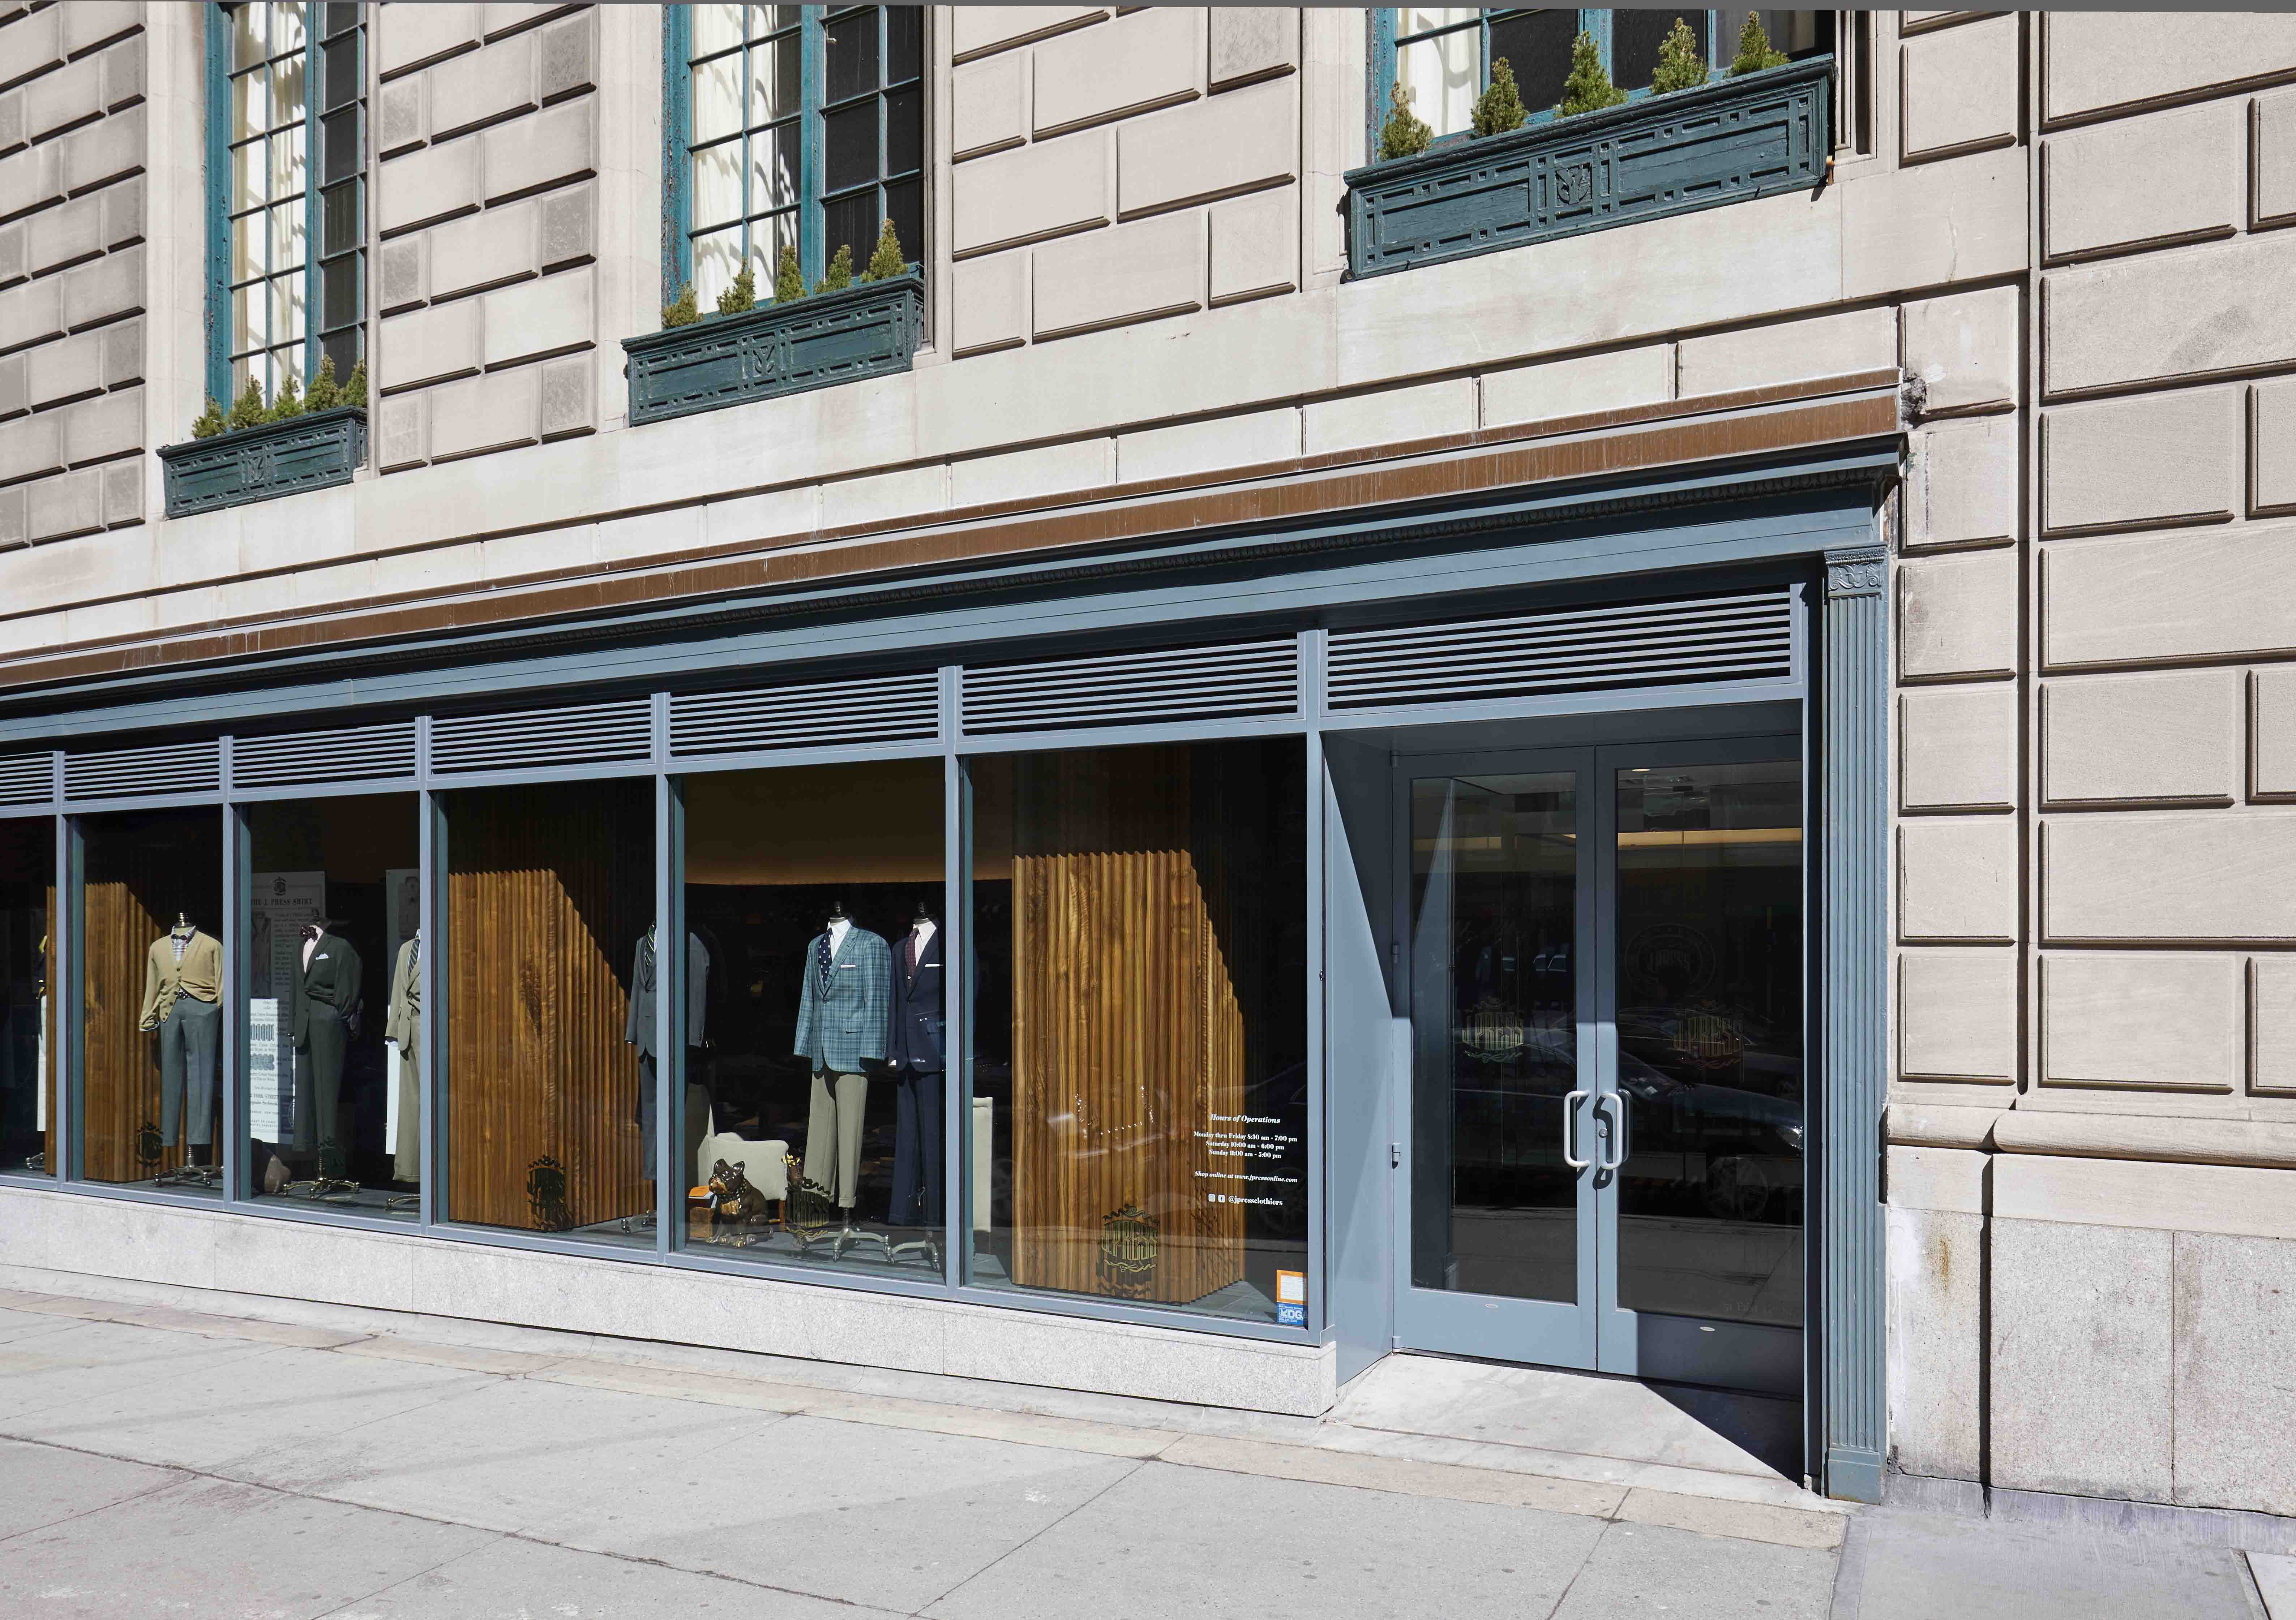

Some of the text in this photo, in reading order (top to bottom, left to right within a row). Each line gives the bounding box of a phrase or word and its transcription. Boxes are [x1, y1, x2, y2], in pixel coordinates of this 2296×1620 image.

[1475, 1012, 1524, 1050] PRESS
[1234, 1174, 1298, 1183] www.jpressonline.com
[1228, 1195, 1283, 1206] @jpressclothiers
[1113, 1219, 1157, 1260] PRESS
